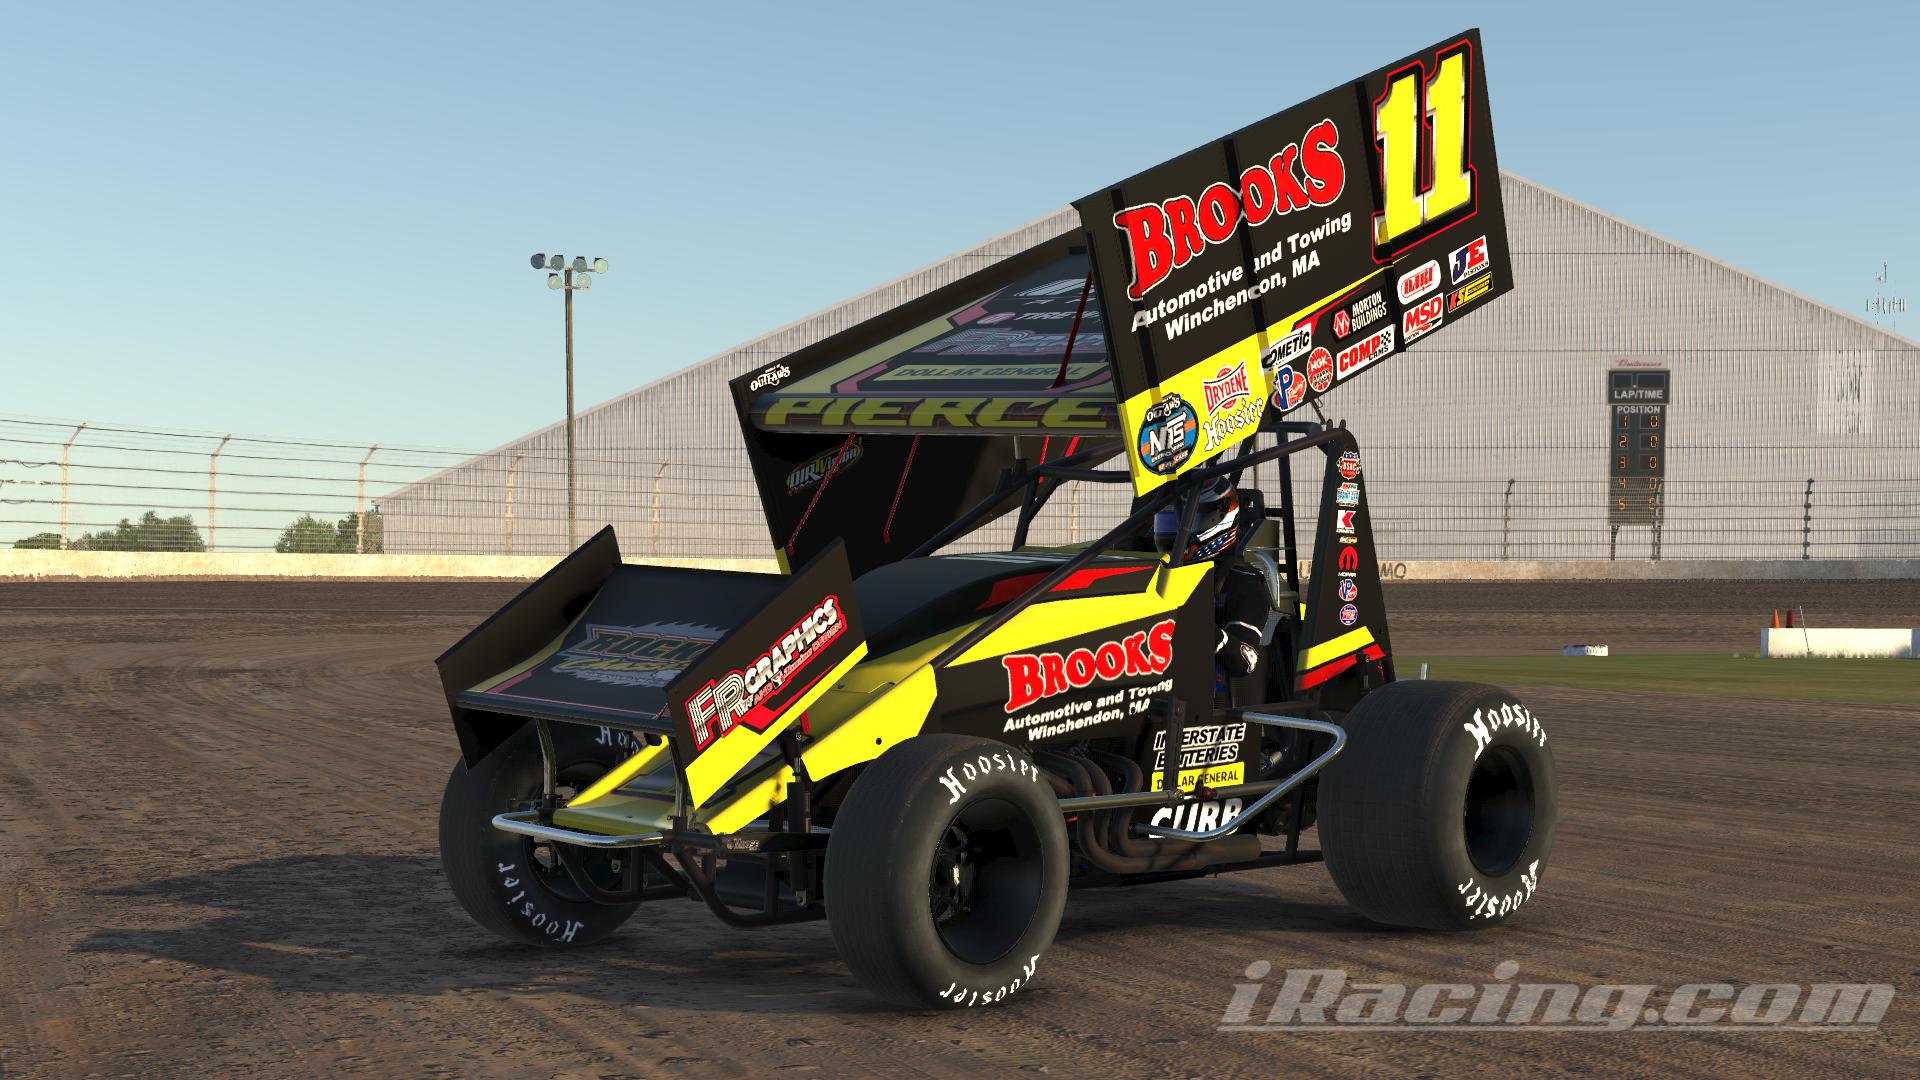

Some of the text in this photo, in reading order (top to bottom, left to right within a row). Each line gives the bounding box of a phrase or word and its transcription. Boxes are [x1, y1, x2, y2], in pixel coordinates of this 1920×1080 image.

[1374, 48, 1474, 250] 11
[1113, 118, 1344, 300] BROOKS
[1131, 264, 1243, 332] Automotive
[1287, 212, 1352, 253] Towing
[1292, 250, 1320, 278] MA
[1453, 239, 1484, 282] JE
[1463, 261, 1488, 278] PISTONS
[1351, 302, 1387, 332] BUILDINGS
[1352, 290, 1382, 317] MORTON
[1405, 296, 1442, 333] MSD
[1310, 355, 1328, 372] NGK
[1340, 335, 1381, 373] COMP
[1369, 346, 1389, 361] CAMS
[893, 368, 981, 377] DOLLAR
[1204, 366, 1249, 412] DRYDENE
[1614, 389, 1664, 399] LAP/TIME
[1617, 405, 1660, 415] POSITION
[764, 398, 1108, 428] PIERCE
[1203, 398, 1263, 452] Hoosier
[745, 598, 838, 694] GRAPHICS
[1002, 619, 1175, 713] BROOKS
[688, 673, 746, 744] FR
[1003, 700, 1092, 733] Automotive
[1096, 690, 1124, 708] and
[1028, 708, 1124, 741] Winchendon,
[1153, 723, 1246, 750] INERSTATE
[1464, 703, 1547, 760] Hoosier
[1154, 743, 1239, 771] BTTERIES
[938, 749, 1038, 804] Hoosier
[1149, 798, 1242, 838] CURB
